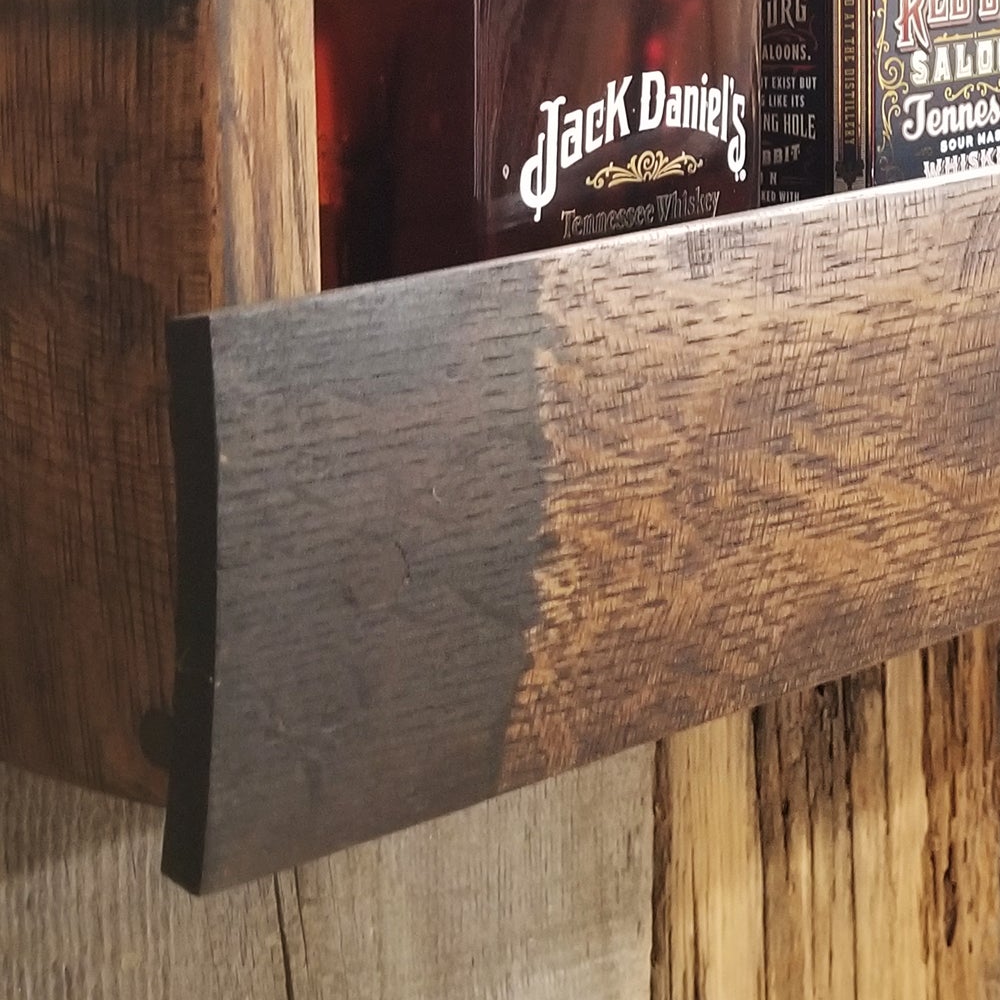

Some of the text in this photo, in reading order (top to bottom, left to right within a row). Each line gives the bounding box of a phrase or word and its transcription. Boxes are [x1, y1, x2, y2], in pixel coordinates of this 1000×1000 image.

[844, 13, 855, 30] AT
[762, 43, 812, 61] ALOONS.
[844, 36, 855, 62] THE
[771, 76, 796, 90] EXIST
[799, 76, 817, 90] BUT
[768, 95, 788, 108] LIKE
[791, 95, 806, 108] ITS
[844, 68, 855, 147] DISTILLERY
[638, 69, 747, 182] Daniel's
[763, 113, 817, 141] NG HOLE
[940, 134, 974, 153] SOUR
[762, 143, 801, 167] BBIT
[761, 190, 800, 202] KED WITH
[560, 186, 721, 240] Tennessee Whiskey
